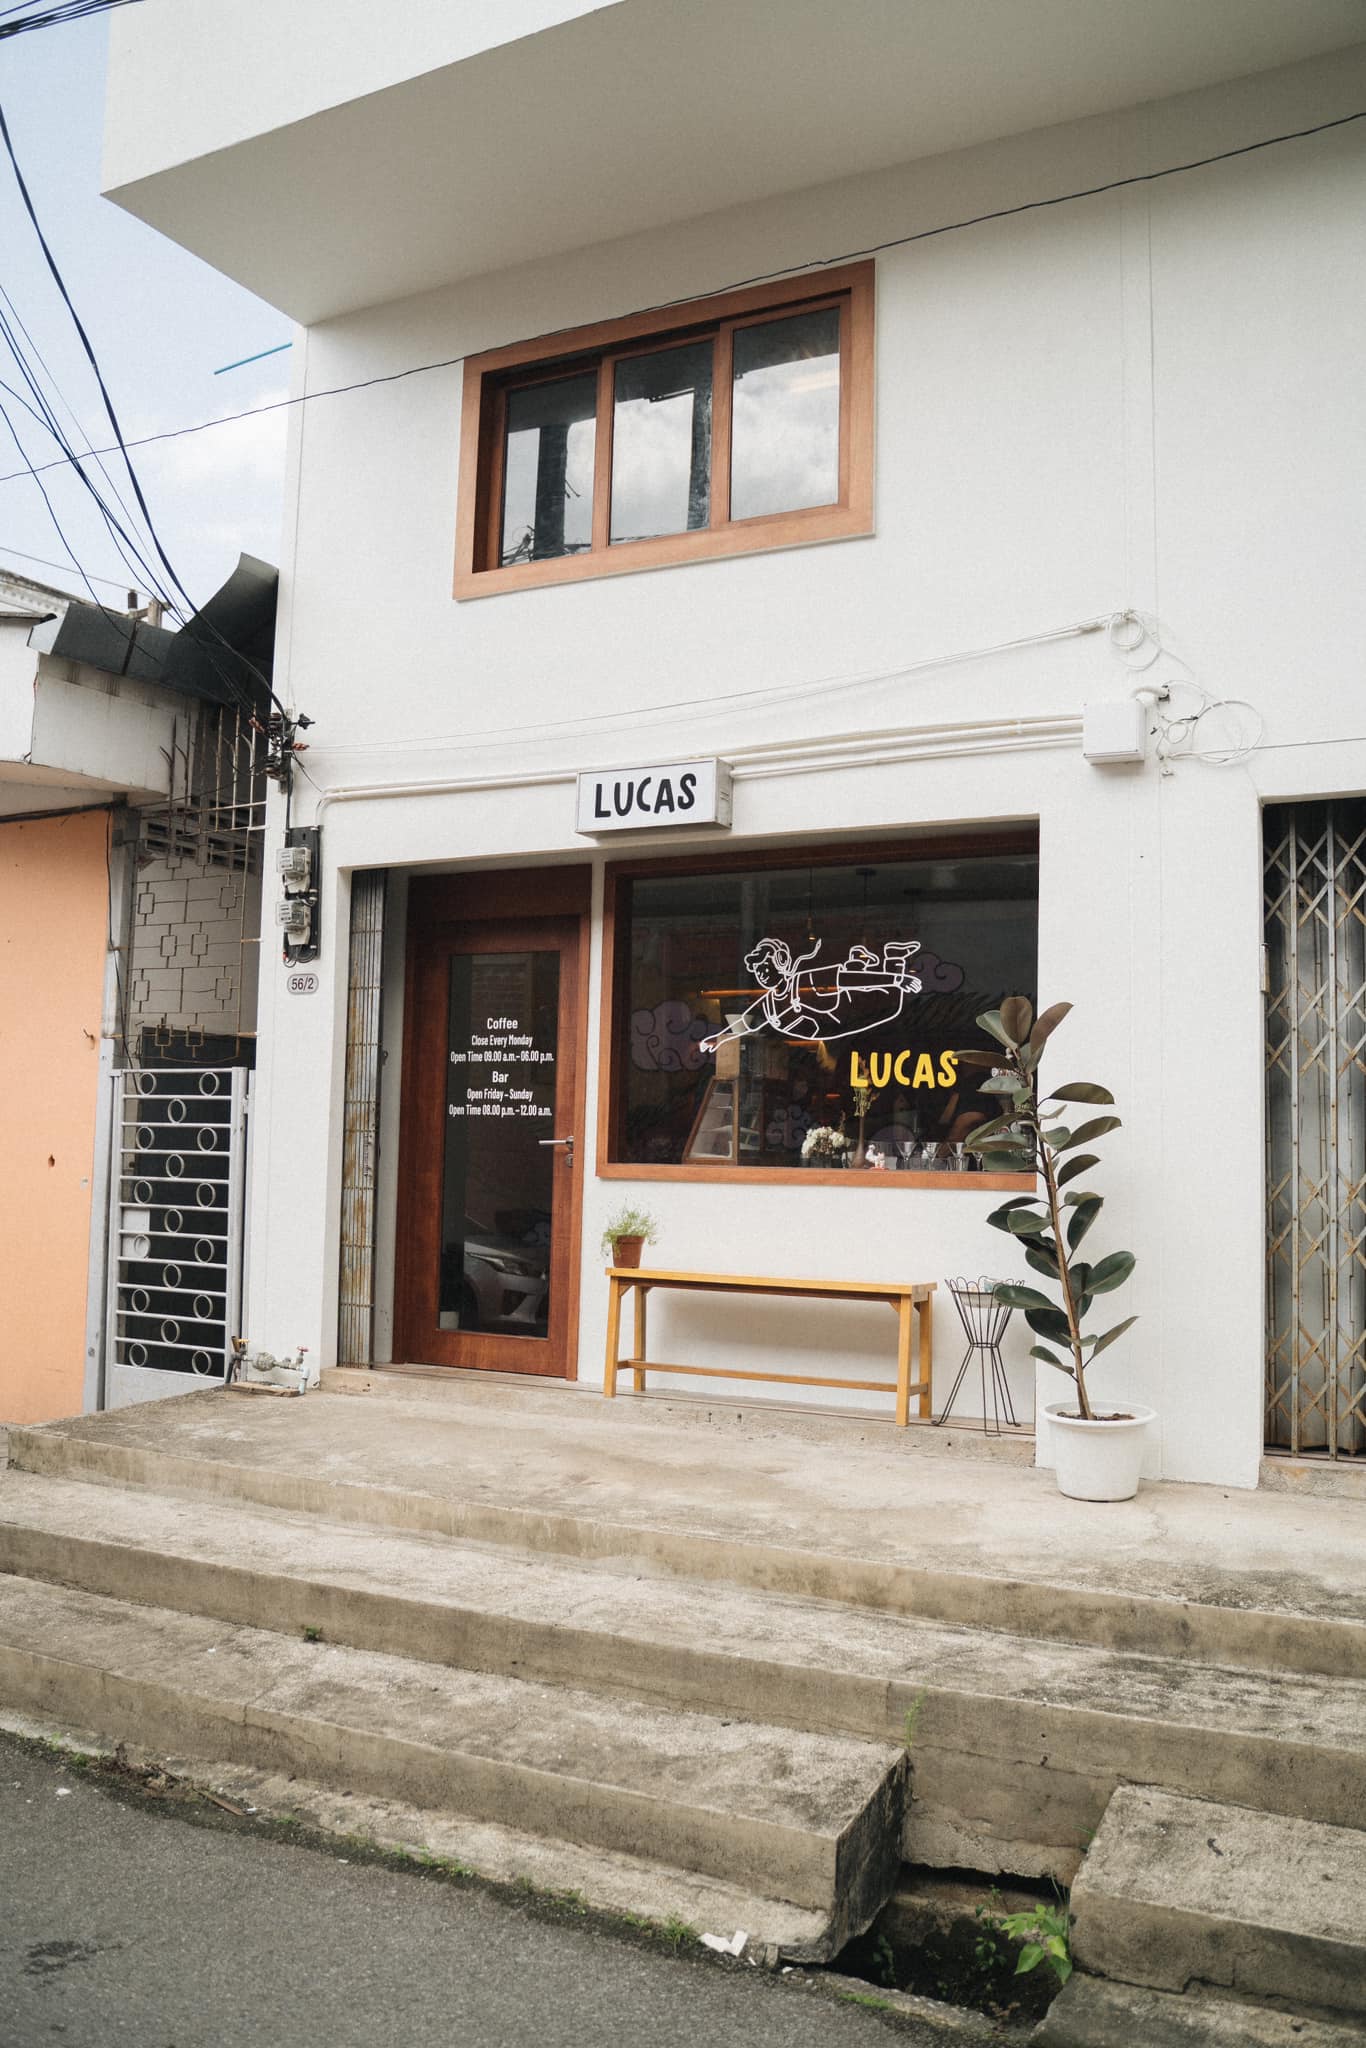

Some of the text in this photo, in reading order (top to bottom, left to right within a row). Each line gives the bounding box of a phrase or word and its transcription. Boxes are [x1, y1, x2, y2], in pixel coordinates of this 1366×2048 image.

[594, 773, 697, 818] LUCAS
[291, 976, 314, 991] 56/2
[487, 1017, 518, 1030] Coffee
[471, 1034, 533, 1048] Close Every Monday
[450, 1051, 466, 1064] Open
[467, 1051, 483, 1062] Time
[520, 1050, 539, 1062] 06.00
[540, 1053, 554, 1064] p.m.
[850, 1050, 959, 1089] LUCAS
[492, 1071, 509, 1083] Bar
[467, 1088, 483, 1101] Open
[483, 1088, 504, 1102] Friday
[509, 1088, 533, 1102] Sunday
[448, 1104, 465, 1117] Open
[466, 1104, 482, 1116] Time
[482, 1104, 501, 1116] 08.00
[520, 1104, 537, 1116] 12.00
[537, 1106, 552, 1116] a.m.
